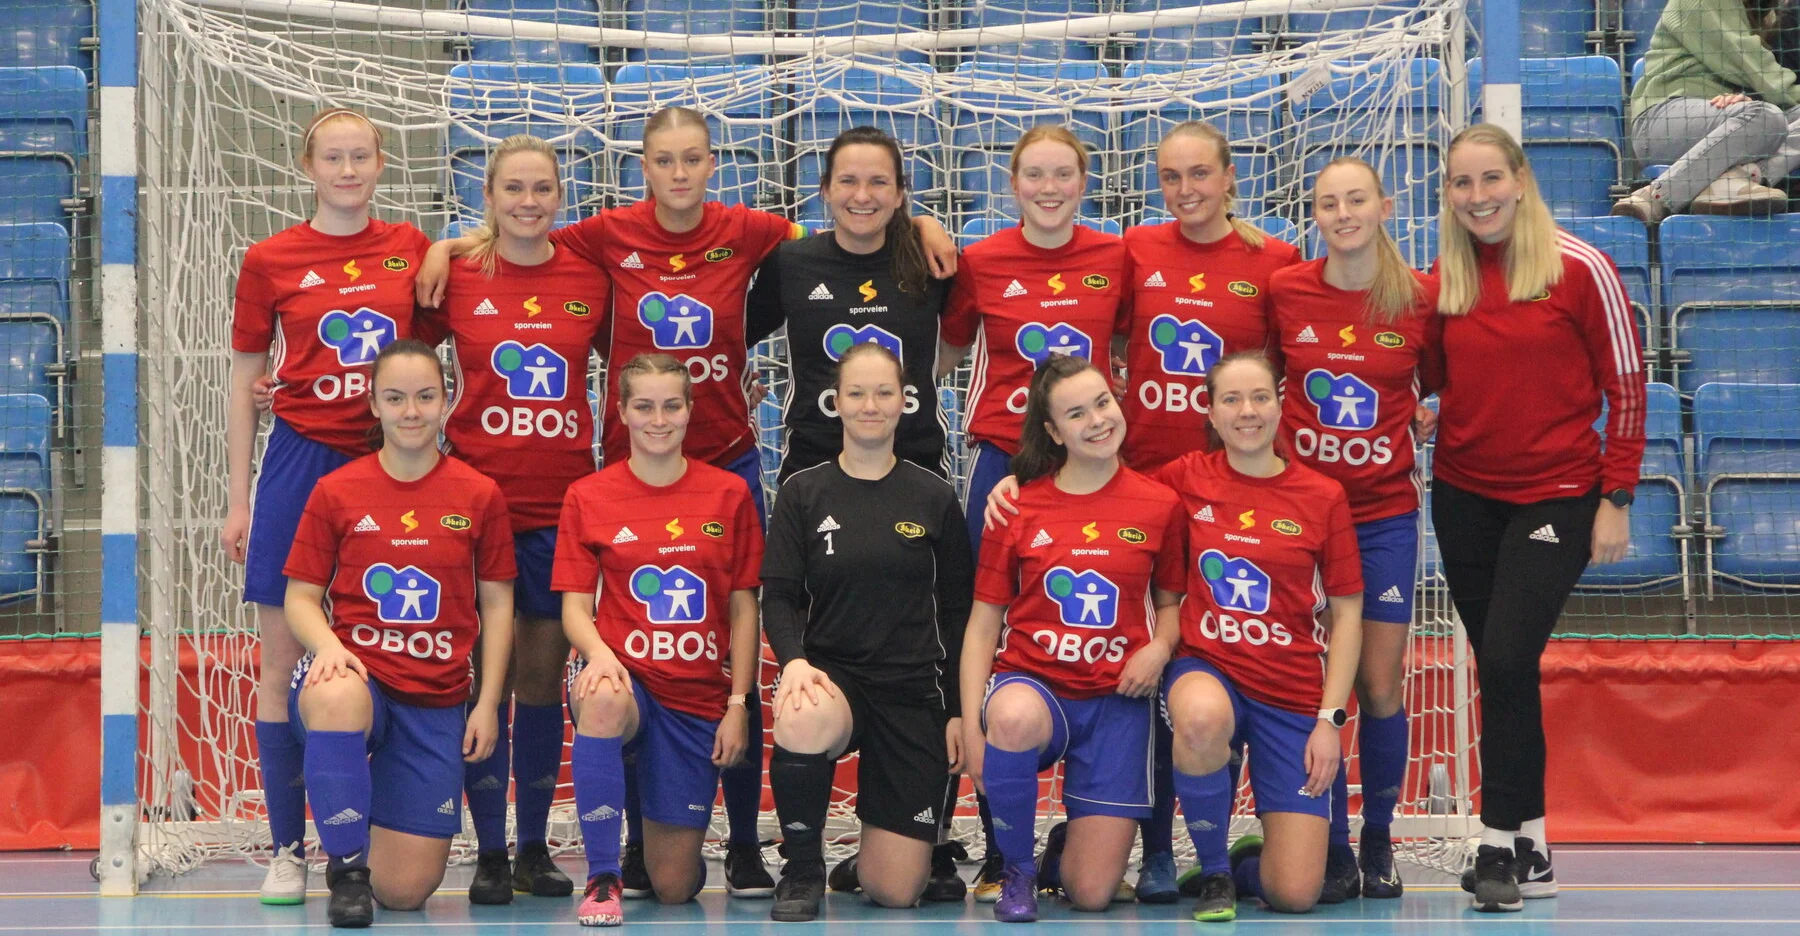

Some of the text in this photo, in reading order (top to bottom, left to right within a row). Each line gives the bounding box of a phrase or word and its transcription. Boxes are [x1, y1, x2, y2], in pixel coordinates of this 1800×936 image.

[299, 278, 325, 288] adidas
[659, 274, 696, 282] sporveien
[339, 284, 376, 295] sporveien
[1003, 288, 1028, 298] adidas
[1040, 298, 1078, 308] sporveien
[1175, 296, 1213, 308] sporveien
[473, 308, 499, 316] adidas
[849, 305, 888, 315] sporveien
[514, 321, 552, 330] sporveien
[1327, 352, 1365, 361] sporveien
[685, 354, 729, 384] OS
[312, 372, 372, 401] OB
[817, 385, 920, 418] OS
[1139, 380, 1209, 414] OBO
[481, 406, 578, 439] OBOS
[1295, 428, 1392, 465] OBOS
[1193, 513, 1215, 523] adidas
[817, 524, 841, 533] adidas
[391, 538, 429, 547] sporveien
[612, 535, 639, 544] adidas
[1030, 537, 1053, 548] adidas
[1224, 533, 1261, 545] sporveien
[1529, 533, 1560, 543] adidas
[824, 532, 834, 555] 1
[658, 544, 696, 554] sporveien
[1072, 548, 1109, 556] sporveien
[1200, 610, 1293, 646] OBOS
[351, 624, 453, 660] OBOS
[624, 629, 718, 661] OBOS
[1033, 630, 1128, 664] OBOS
[913, 815, 935, 825] adidas
